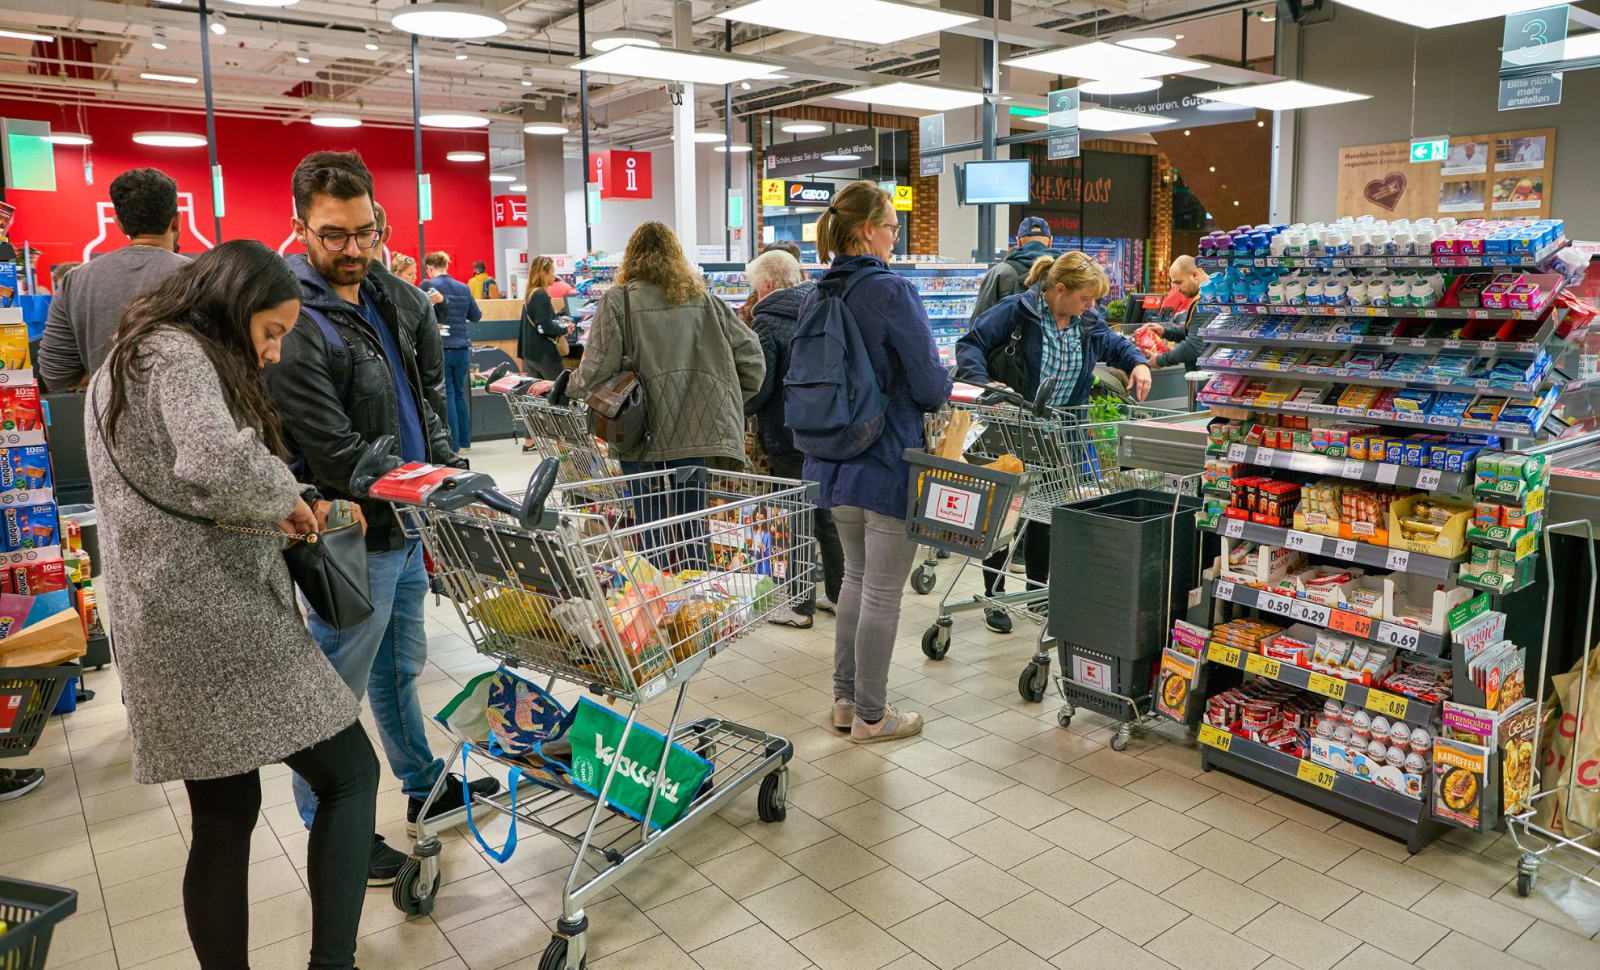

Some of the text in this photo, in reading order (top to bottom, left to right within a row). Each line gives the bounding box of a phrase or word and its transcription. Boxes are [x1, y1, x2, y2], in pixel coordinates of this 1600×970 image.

[1522, 19, 1547, 58] 3
[1507, 75, 1554, 89] Bitte nicht
[1517, 86, 1542, 97] mehr
[1134, 104, 1146, 113] da
[1148, 101, 1180, 112] waren.
[1182, 97, 1207, 107] Gute
[1507, 95, 1550, 106] anstellen
[838, 147, 852, 155] Gute
[852, 144, 874, 153] Woche.
[1422, 476, 1439, 485] 0.89
[8, 514, 20, 547] SUNQUICK
[1291, 537, 1303, 545] 1.19
[1341, 546, 1355, 555] 1.19
[1393, 556, 1407, 565] 1.19
[17, 573, 30, 596] NQUICK
[1307, 594, 1325, 603] duplo
[1267, 599, 1290, 613] 0.59
[1349, 605, 1368, 614] duplo
[1302, 608, 1325, 622] 0.29
[1355, 622, 1370, 634] 0.29
[1390, 631, 1417, 648] 0.69
[1225, 652, 1239, 664] 0.59
[1264, 664, 1278, 676] 0.35
[1329, 683, 1344, 696] 0.30
[1217, 735, 1229, 748] 0.99
[1437, 752, 1482, 771] KARTOFFELN
[1318, 772, 1333, 787] 0.79
